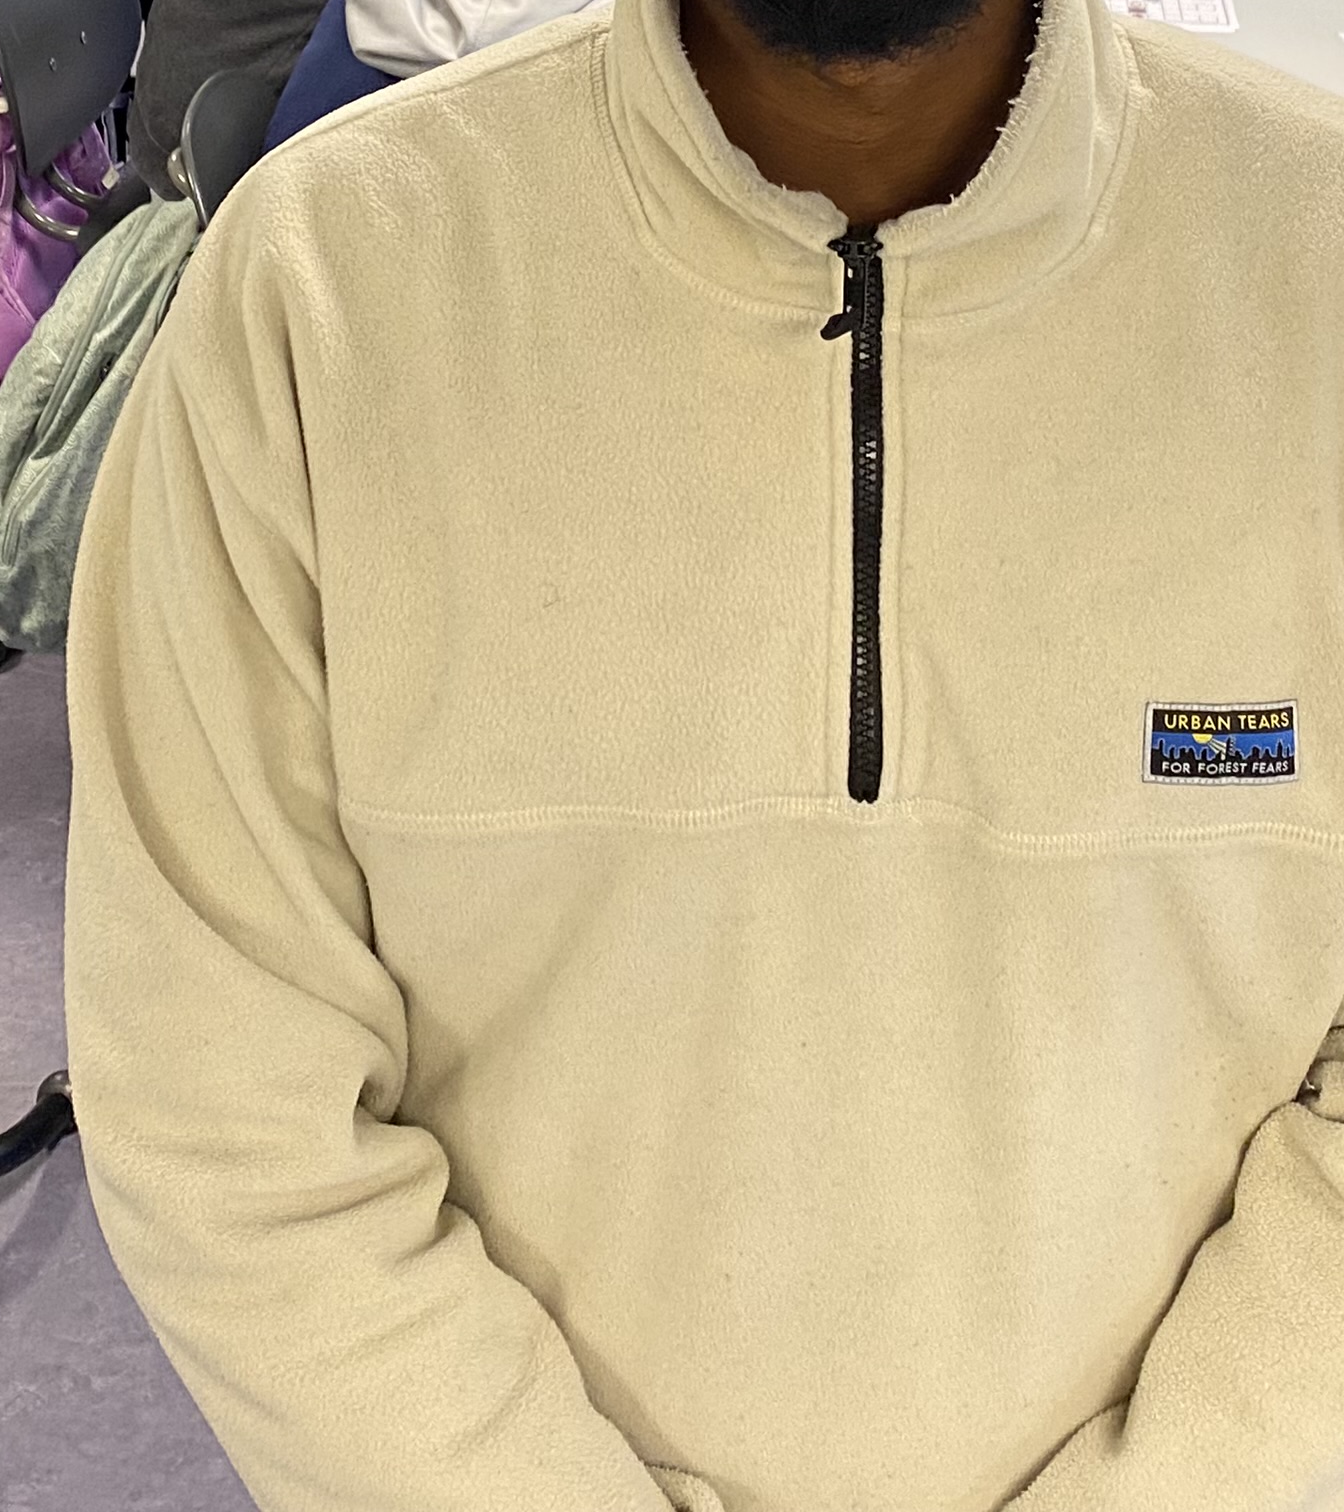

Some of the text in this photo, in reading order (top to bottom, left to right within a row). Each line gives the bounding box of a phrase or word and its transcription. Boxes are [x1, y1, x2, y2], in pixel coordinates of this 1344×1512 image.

[1164, 711, 1290, 731] URBAN TEARS
[1162, 760, 1289, 776] FOR FOREST FEARS
